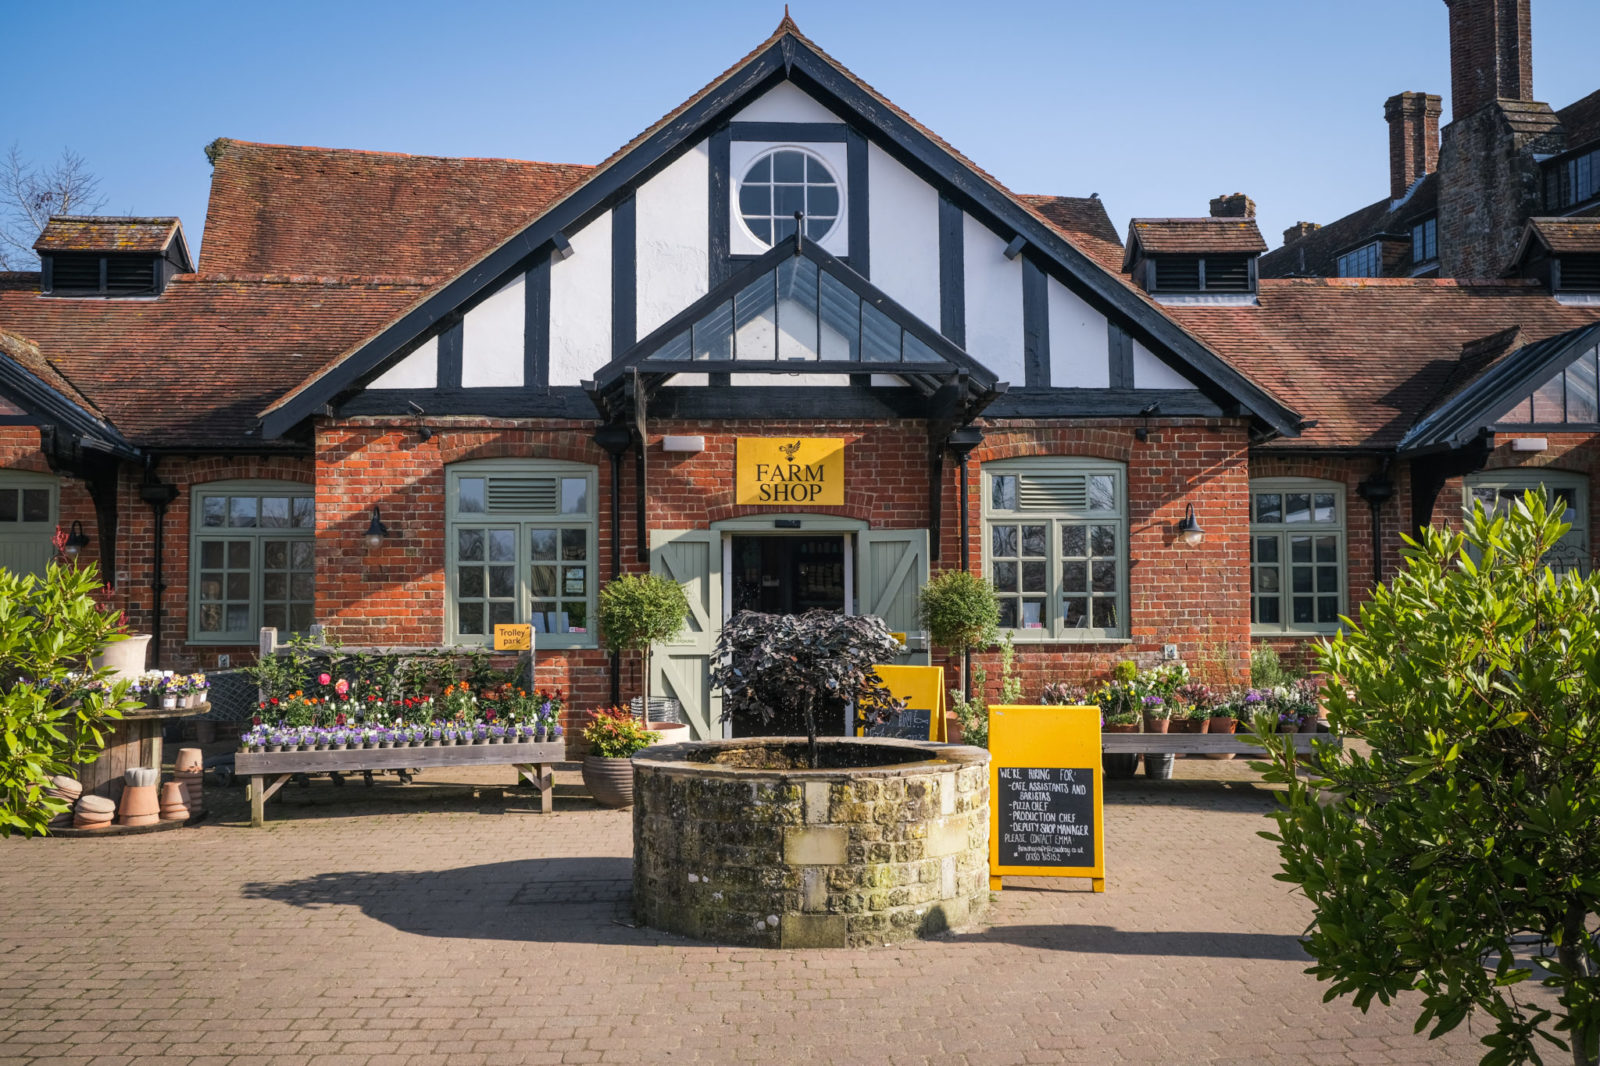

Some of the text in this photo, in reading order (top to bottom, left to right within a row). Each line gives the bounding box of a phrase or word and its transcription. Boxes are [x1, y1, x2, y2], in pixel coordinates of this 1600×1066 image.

[756, 464, 824, 482] FARM
[759, 483, 822, 502] SHOP
[499, 628, 525, 638] Trolley
[503, 637, 521, 646] park
[1000, 768, 1022, 779] WE'RE
[1028, 769, 1050, 780] HIRING
[1029, 782, 1069, 794] ASSISTANTS
[1071, 784, 1086, 795] AND
[1020, 791, 1051, 802] BARISTAS
[1031, 801, 1049, 812] CHEF
[1058, 813, 1076, 823] CHEF
[1040, 823, 1056, 834] SHOP
[1057, 824, 1088, 836] MANAGER
[1004, 833, 1027, 843] PLEASE
[1030, 834, 1052, 844] CONTACT
